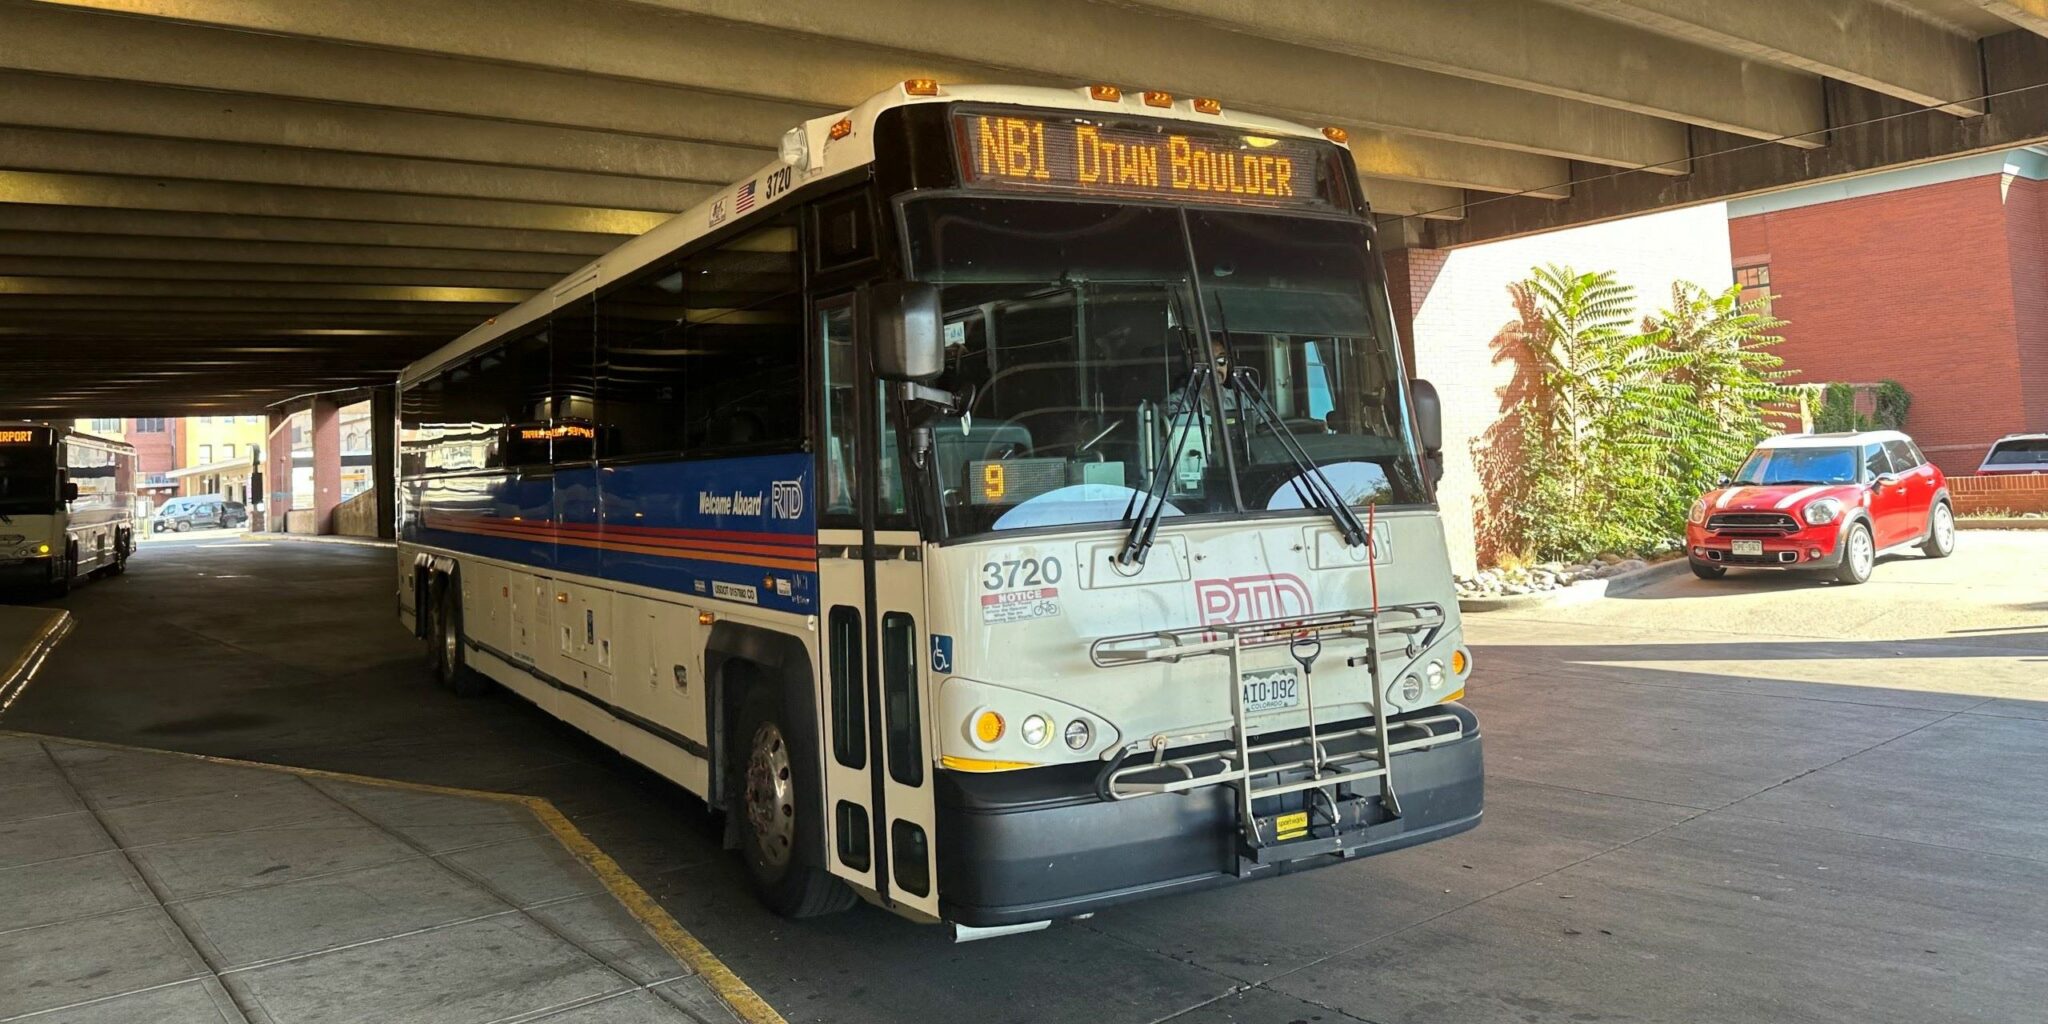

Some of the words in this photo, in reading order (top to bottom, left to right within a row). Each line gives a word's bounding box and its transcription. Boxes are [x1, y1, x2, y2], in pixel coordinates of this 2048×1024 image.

[977, 115, 1050, 180] NB1
[766, 166, 791, 199] 3720
[985, 464, 1004, 497] 9
[699, 491, 731, 515] Welcome
[732, 490, 762, 515] Aboard
[772, 480, 803, 519] RTD
[983, 556, 1062, 590] 3720
[998, 590, 1042, 602] NOTICE
[1195, 573, 1314, 644] RTD
